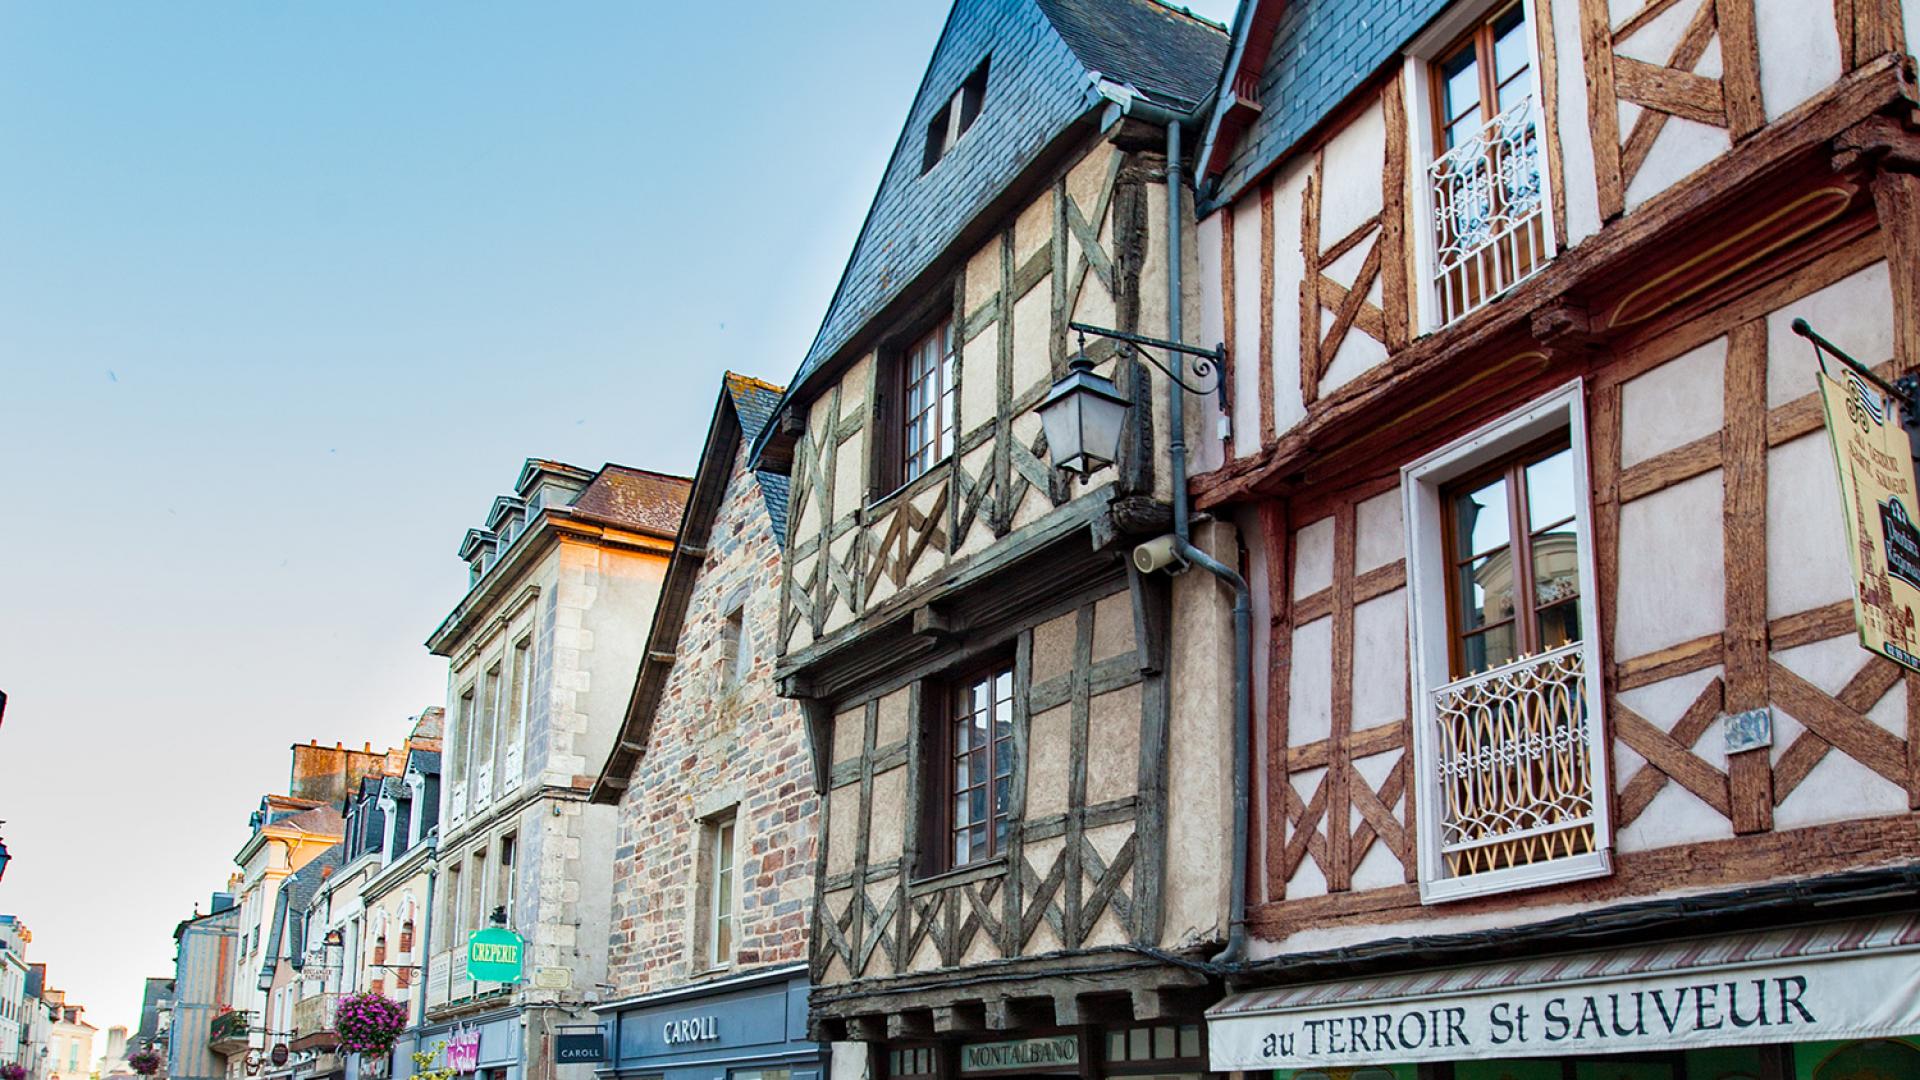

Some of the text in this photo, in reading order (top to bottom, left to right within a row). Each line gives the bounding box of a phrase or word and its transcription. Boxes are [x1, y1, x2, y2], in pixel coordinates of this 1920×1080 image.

[663, 1015, 719, 1045] CAROLL
[1262, 974, 1817, 1058] au TERROIR St SAUVEUR
[561, 1047, 600, 1059] CAROLL
[967, 1038, 1076, 1067] MONTALBANO
